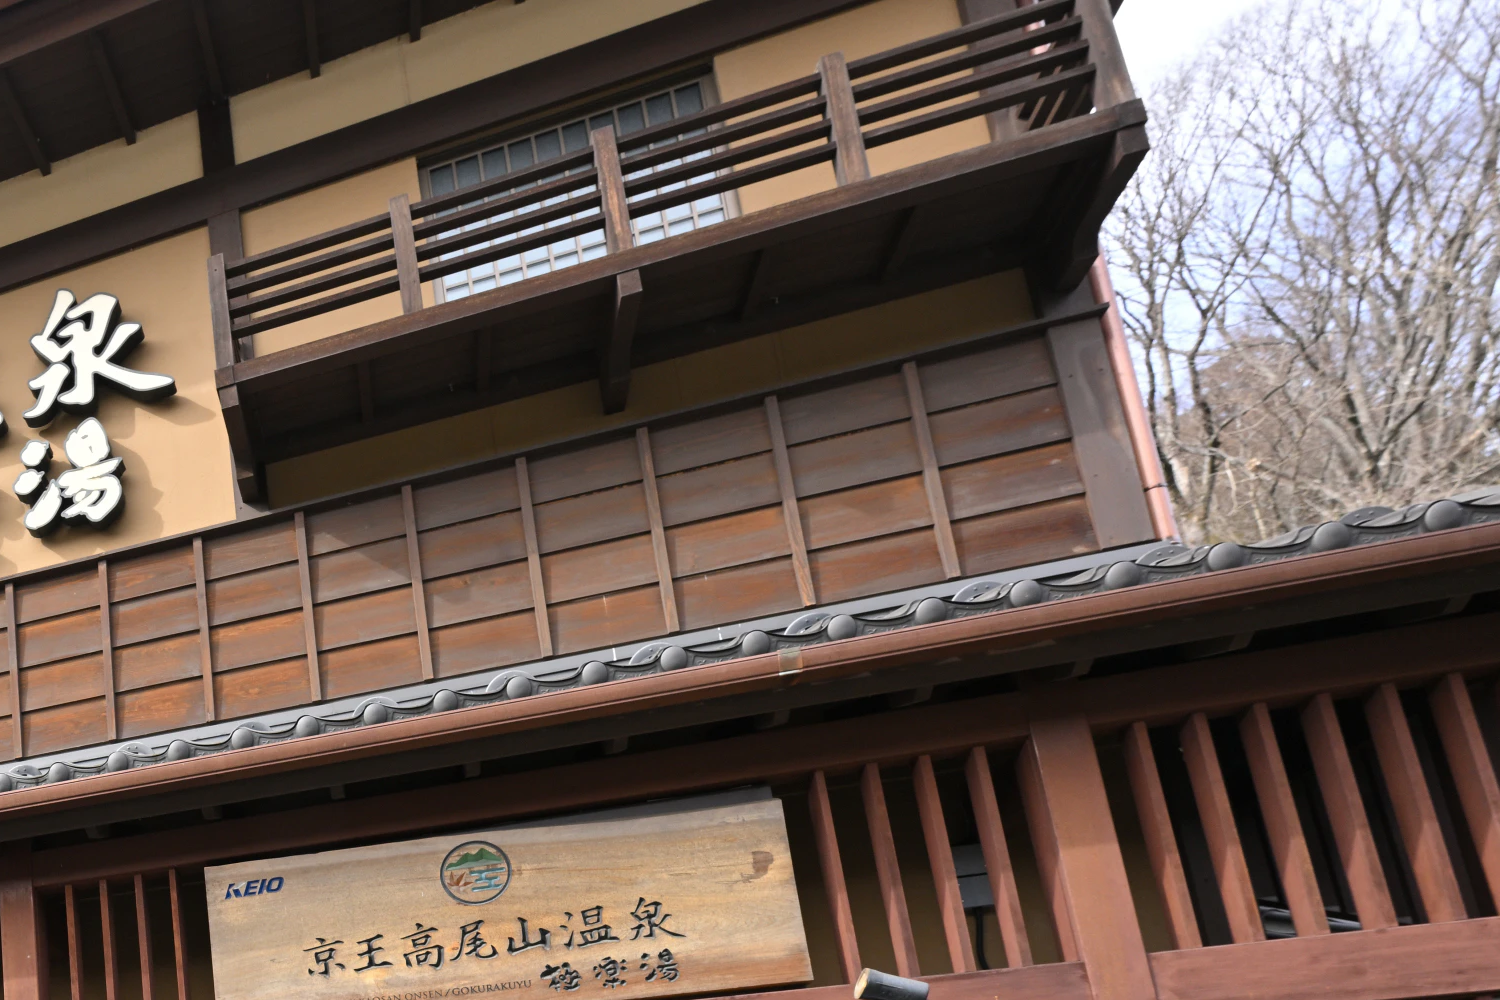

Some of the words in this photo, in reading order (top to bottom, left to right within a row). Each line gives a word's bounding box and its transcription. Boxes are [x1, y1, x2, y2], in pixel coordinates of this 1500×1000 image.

[225, 876, 284, 899] KEIO
[303, 896, 687, 979] 京王高尾山温泉
[540, 948, 679, 992] 極楽湯
